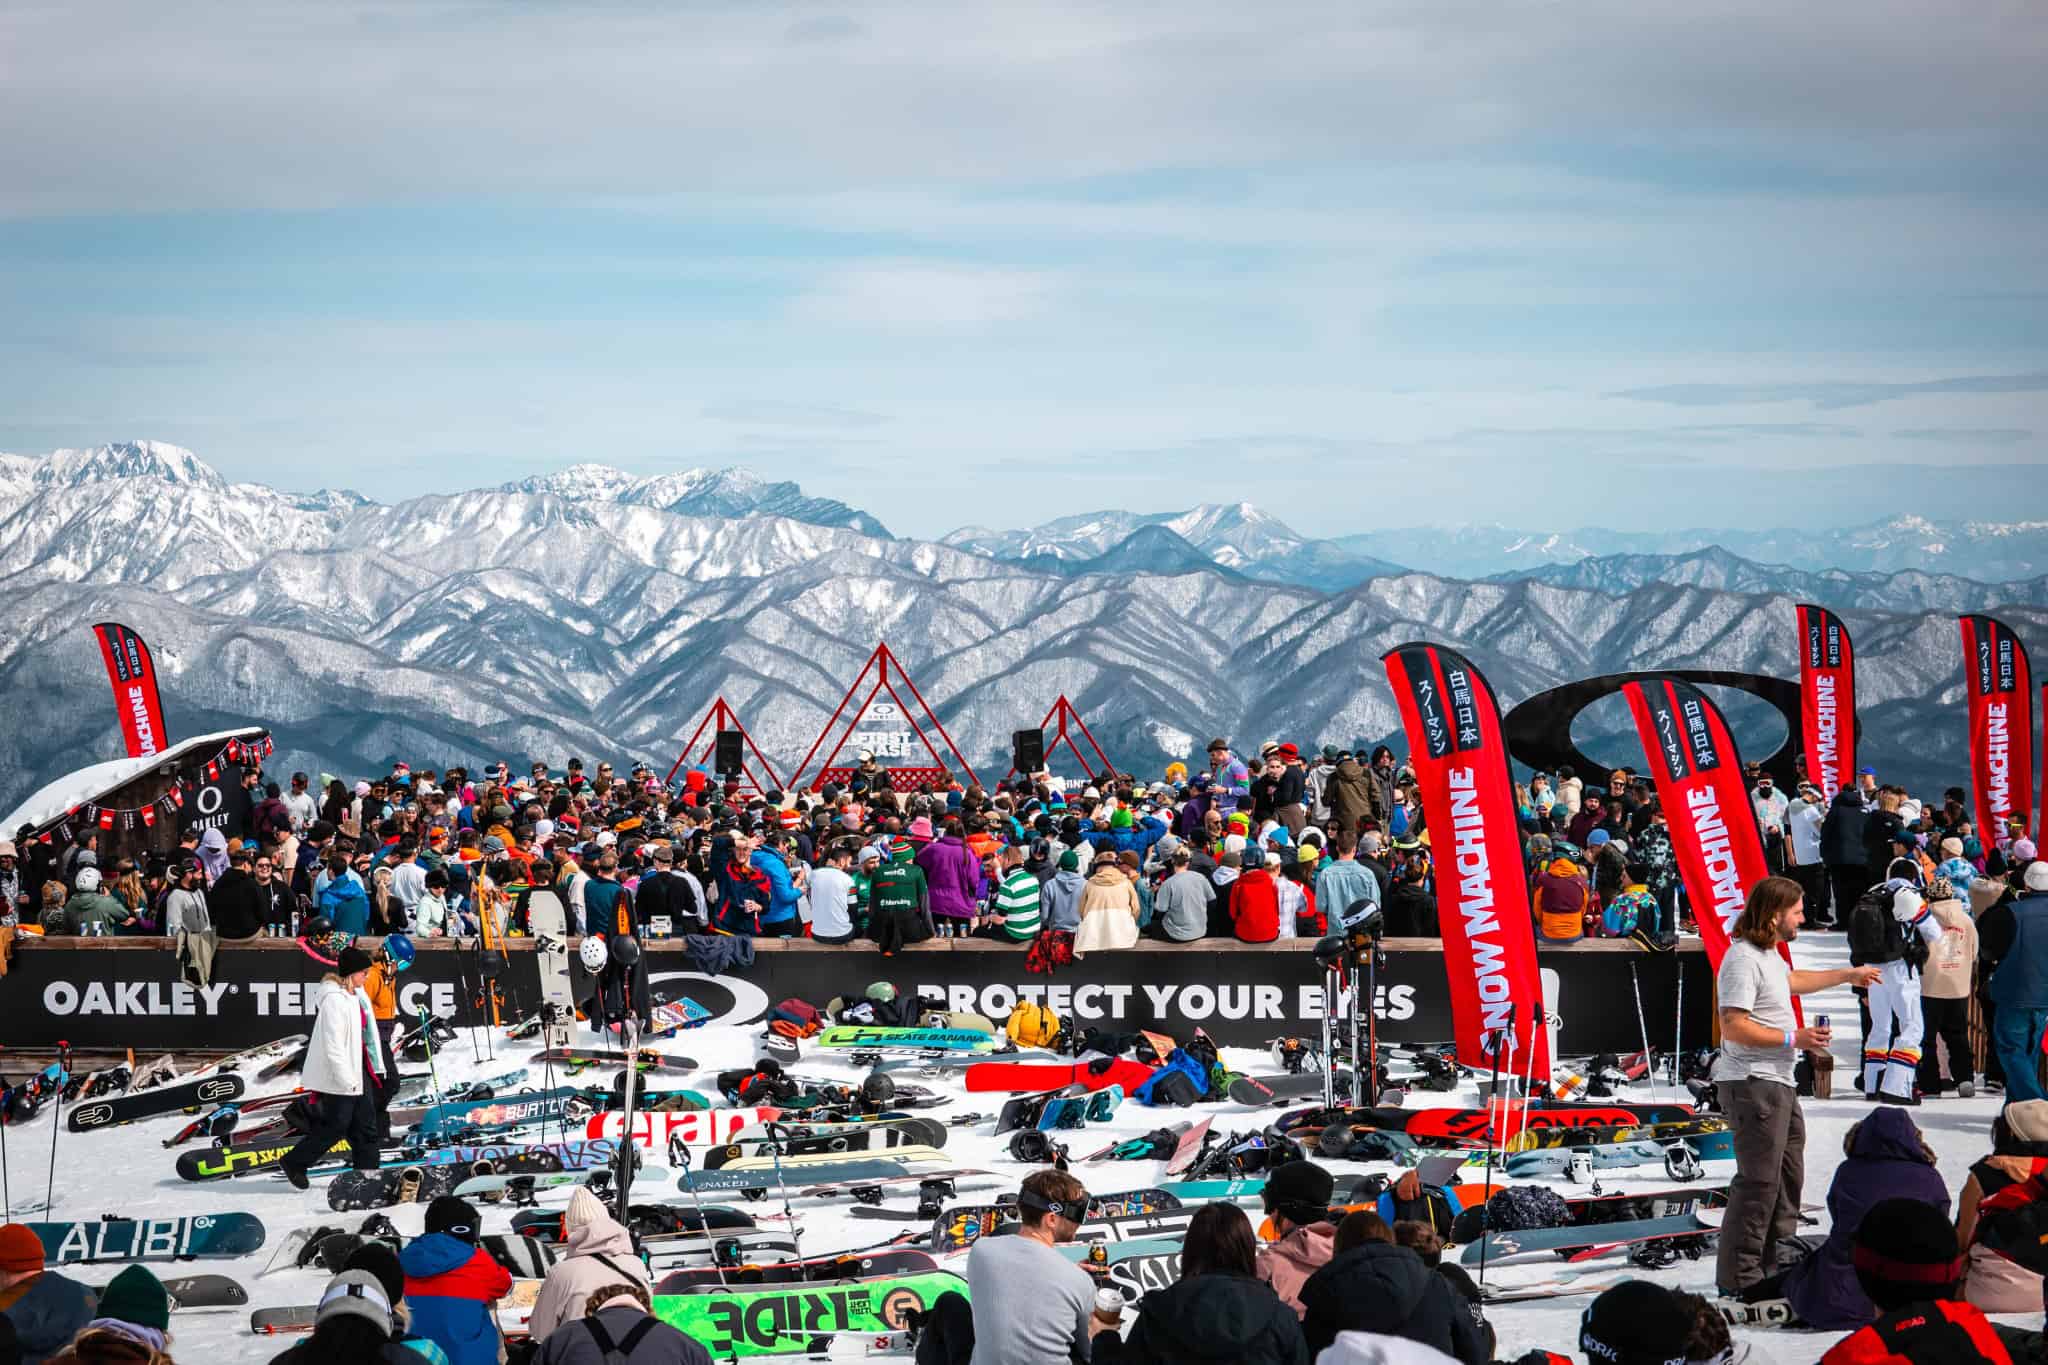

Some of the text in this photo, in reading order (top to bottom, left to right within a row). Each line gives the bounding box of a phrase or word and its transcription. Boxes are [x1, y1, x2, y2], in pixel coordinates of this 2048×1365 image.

[128, 685, 157, 757] ACHINE
[1418, 680, 1446, 754] スノーマシン
[1449, 670, 1478, 744] 白馬日本
[1684, 700, 1714, 766] 白馬日本
[1816, 675, 1838, 761] MACHINE
[1988, 702, 2011, 813] MACHINE
[192, 812, 229, 831] OAKLEY
[1449, 767, 1519, 1056] SNOW MACHINE
[249, 982, 456, 1016] TERCE
[1143, 984, 1285, 1020] YOUR
[886, 1033, 926, 1041] SKATE
[929, 1033, 985, 1042] BANANA
[603, 1108, 758, 1147] elan
[57, 1216, 193, 1261] ALIBI
[708, 1290, 868, 1351] RIDE
